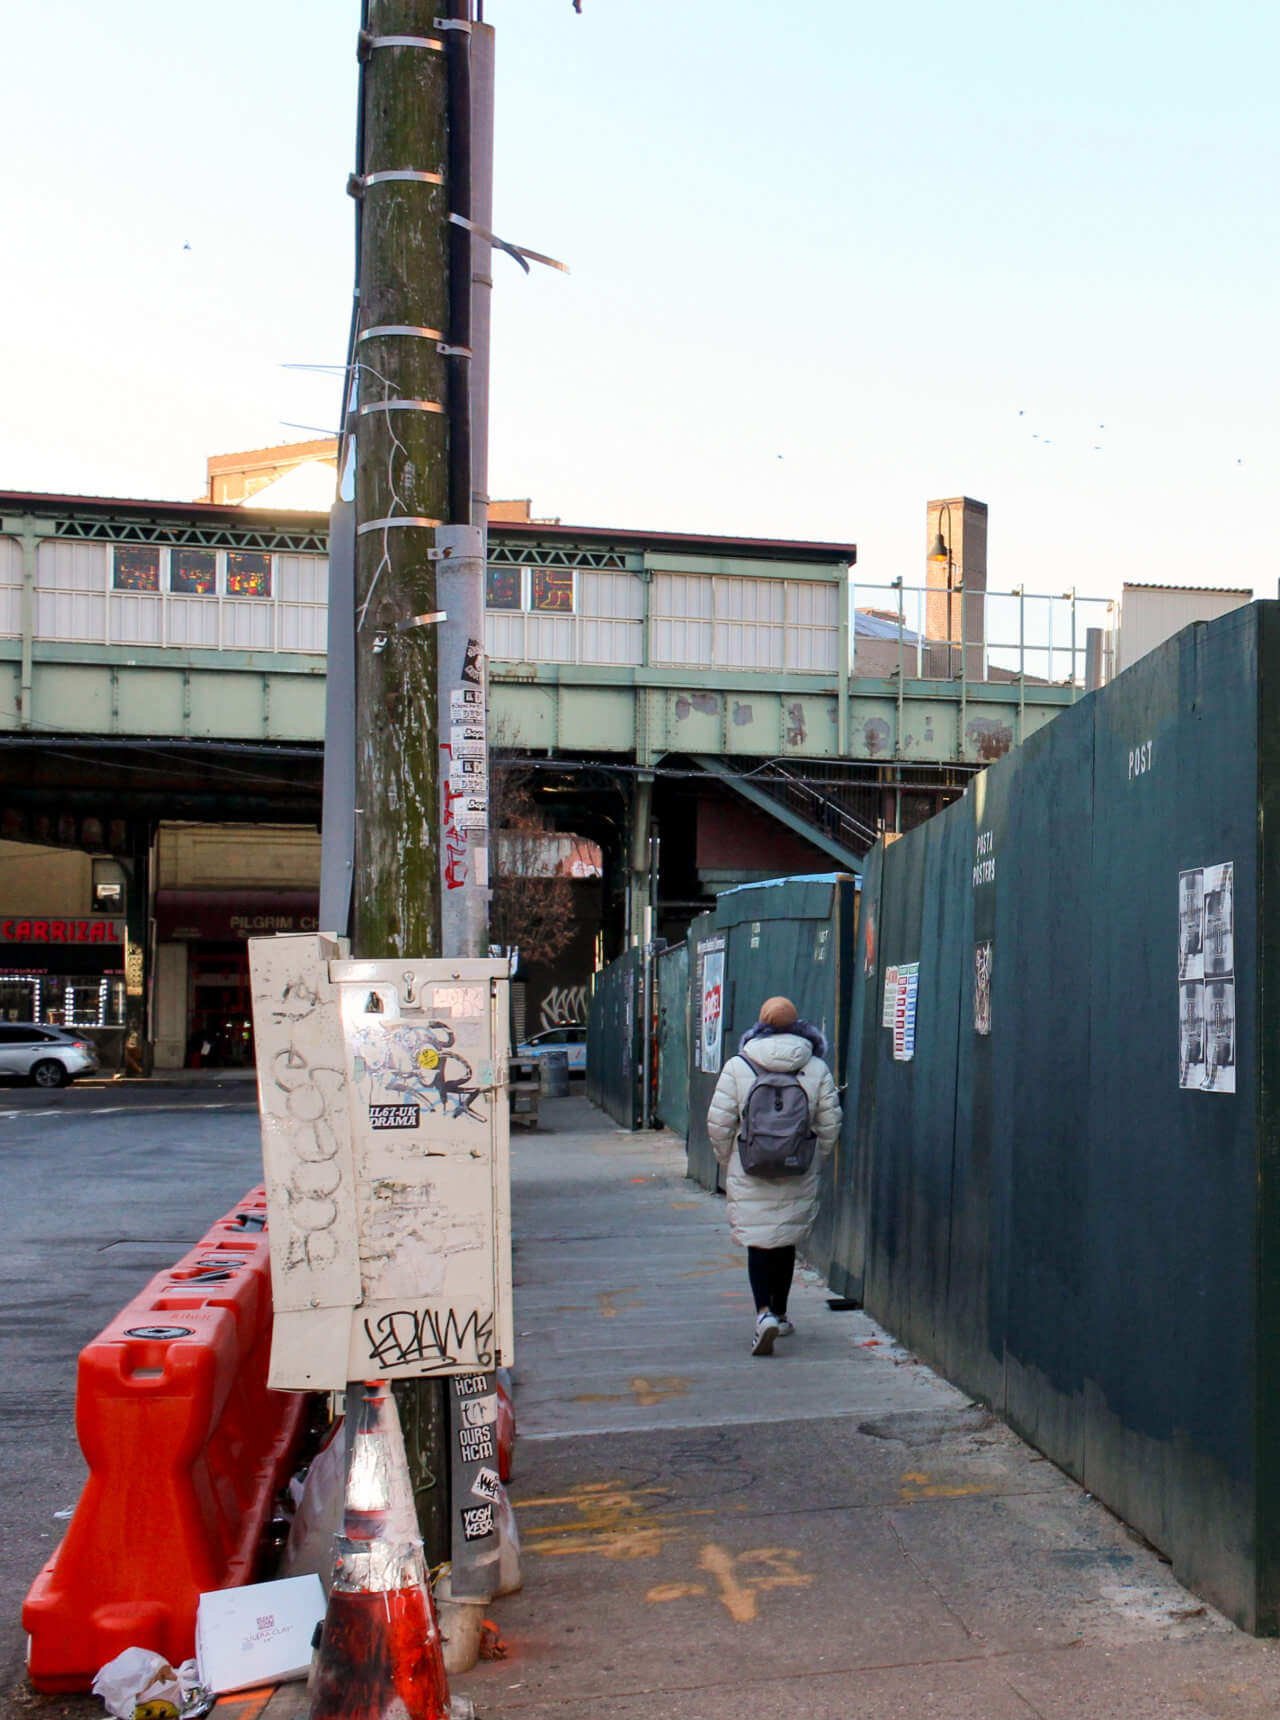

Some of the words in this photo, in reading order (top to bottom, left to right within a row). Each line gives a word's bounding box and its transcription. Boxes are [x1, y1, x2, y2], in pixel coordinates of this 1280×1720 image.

[1128, 740, 1152, 780] POST
[2, 920, 119, 942] CARRIZAL
[230, 916, 293, 929] PILGRIM
[369, 1116, 417, 1127] DRAMA
[459, 1425, 491, 1446] OURS
[463, 1503, 492, 1526] YOSH
